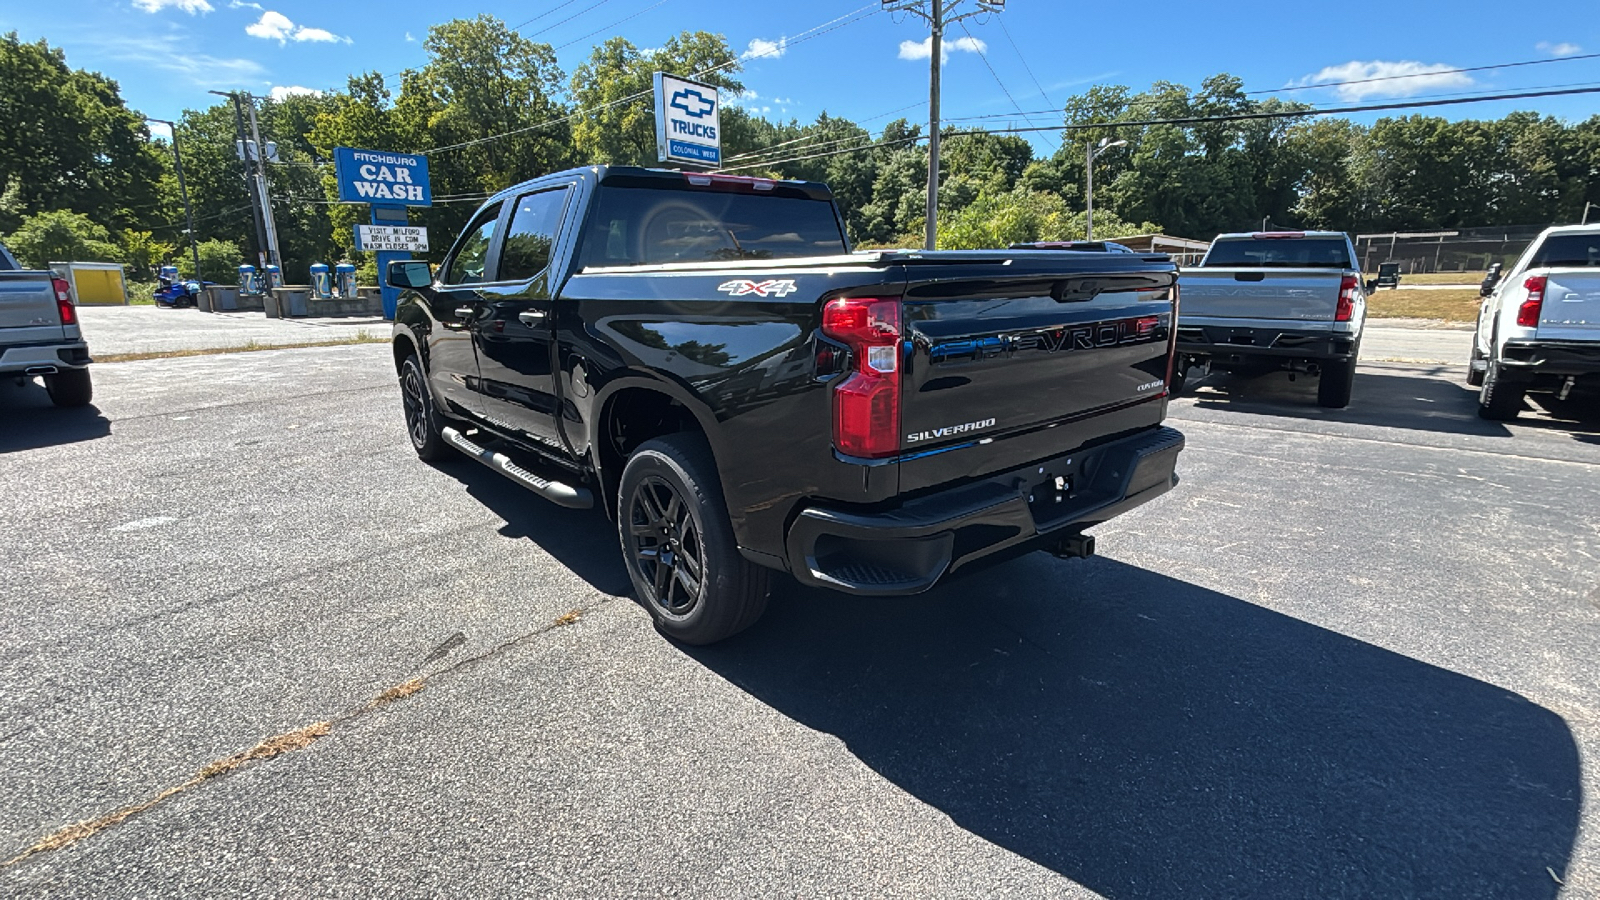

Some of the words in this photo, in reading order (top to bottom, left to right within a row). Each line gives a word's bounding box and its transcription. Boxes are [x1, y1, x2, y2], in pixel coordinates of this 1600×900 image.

[671, 118, 716, 140] TRUCKS
[353, 152, 418, 167] FITCHBURG
[673, 144, 700, 156] COLONIAL
[702, 150, 716, 159] WEST
[360, 164, 413, 183] CAR
[353, 181, 424, 201] WASH
[368, 226, 387, 234] VISIT
[906, 417, 996, 443] SILVERADO
